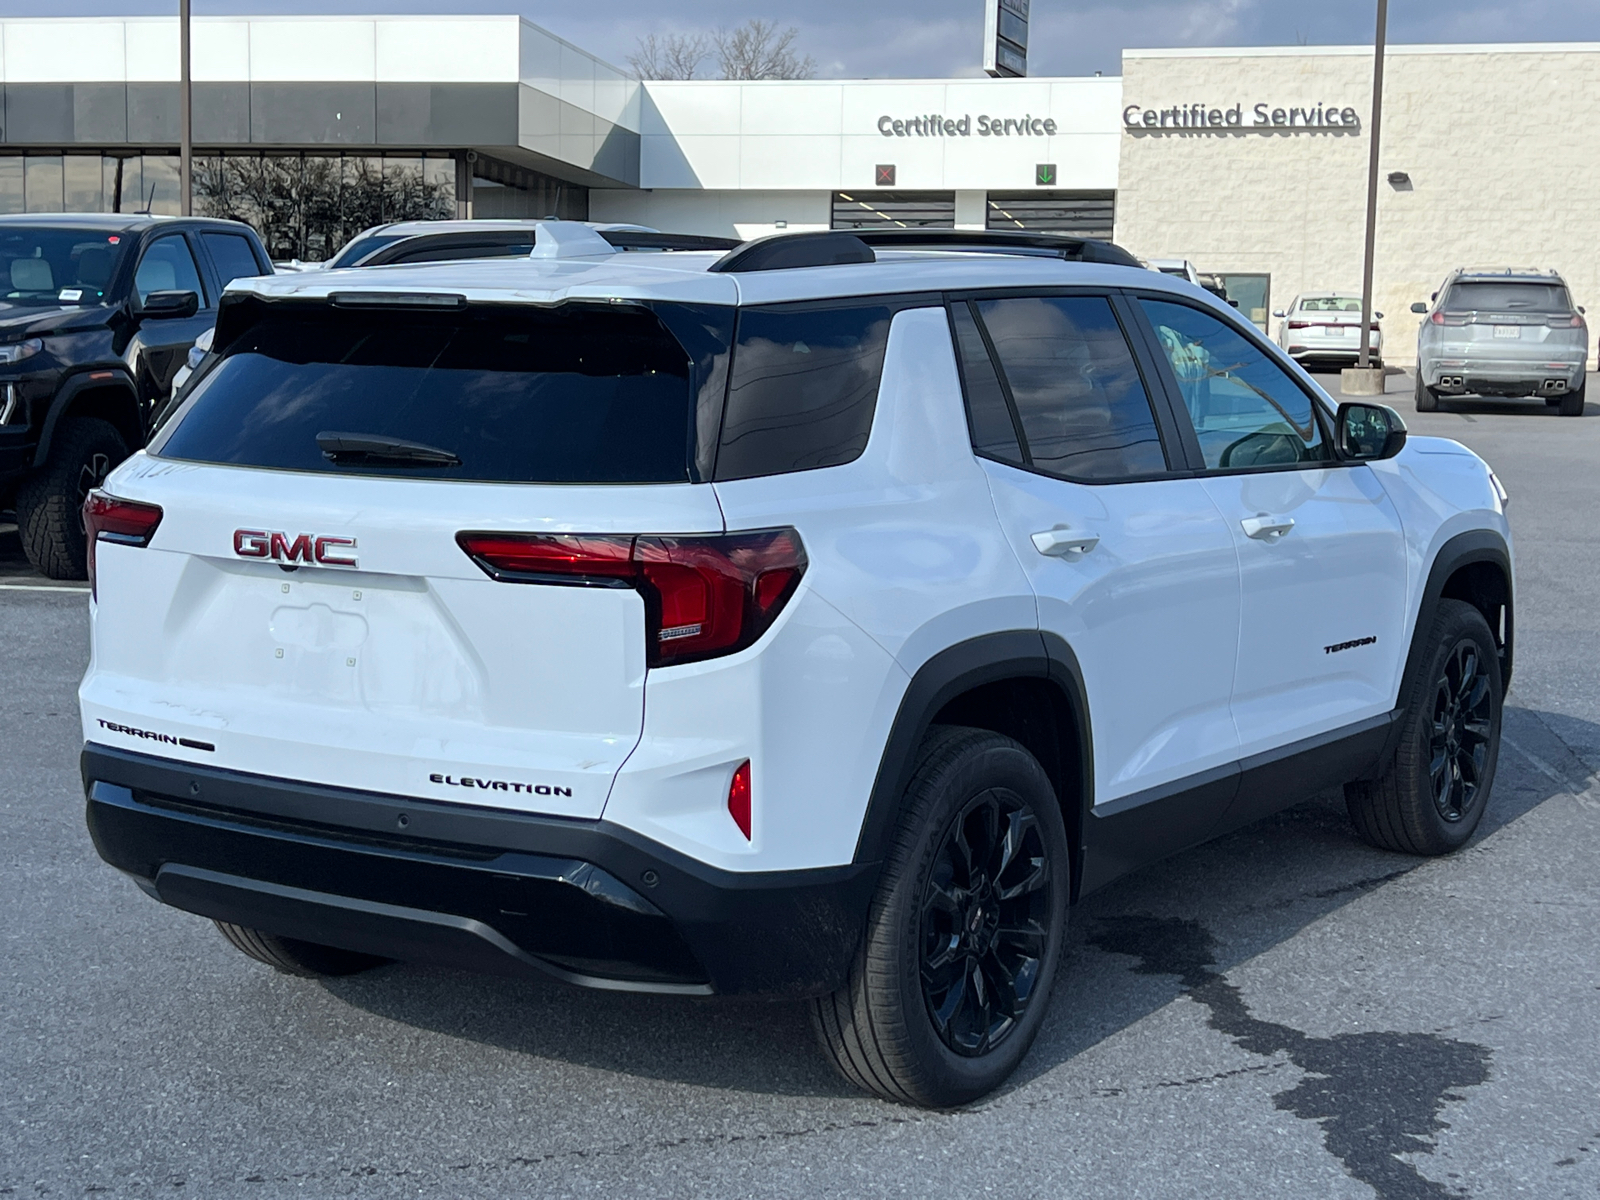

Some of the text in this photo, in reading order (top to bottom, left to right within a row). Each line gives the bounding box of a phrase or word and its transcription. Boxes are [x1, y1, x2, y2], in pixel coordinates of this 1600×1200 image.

[878, 113, 1057, 137] Certified Service
[1123, 102, 1357, 128] Certified Service
[232, 526, 360, 569] GMC
[1323, 635, 1377, 655] TERRAIN
[96, 718, 178, 745] TERRAIN
[429, 773, 572, 797] ELEVATION
